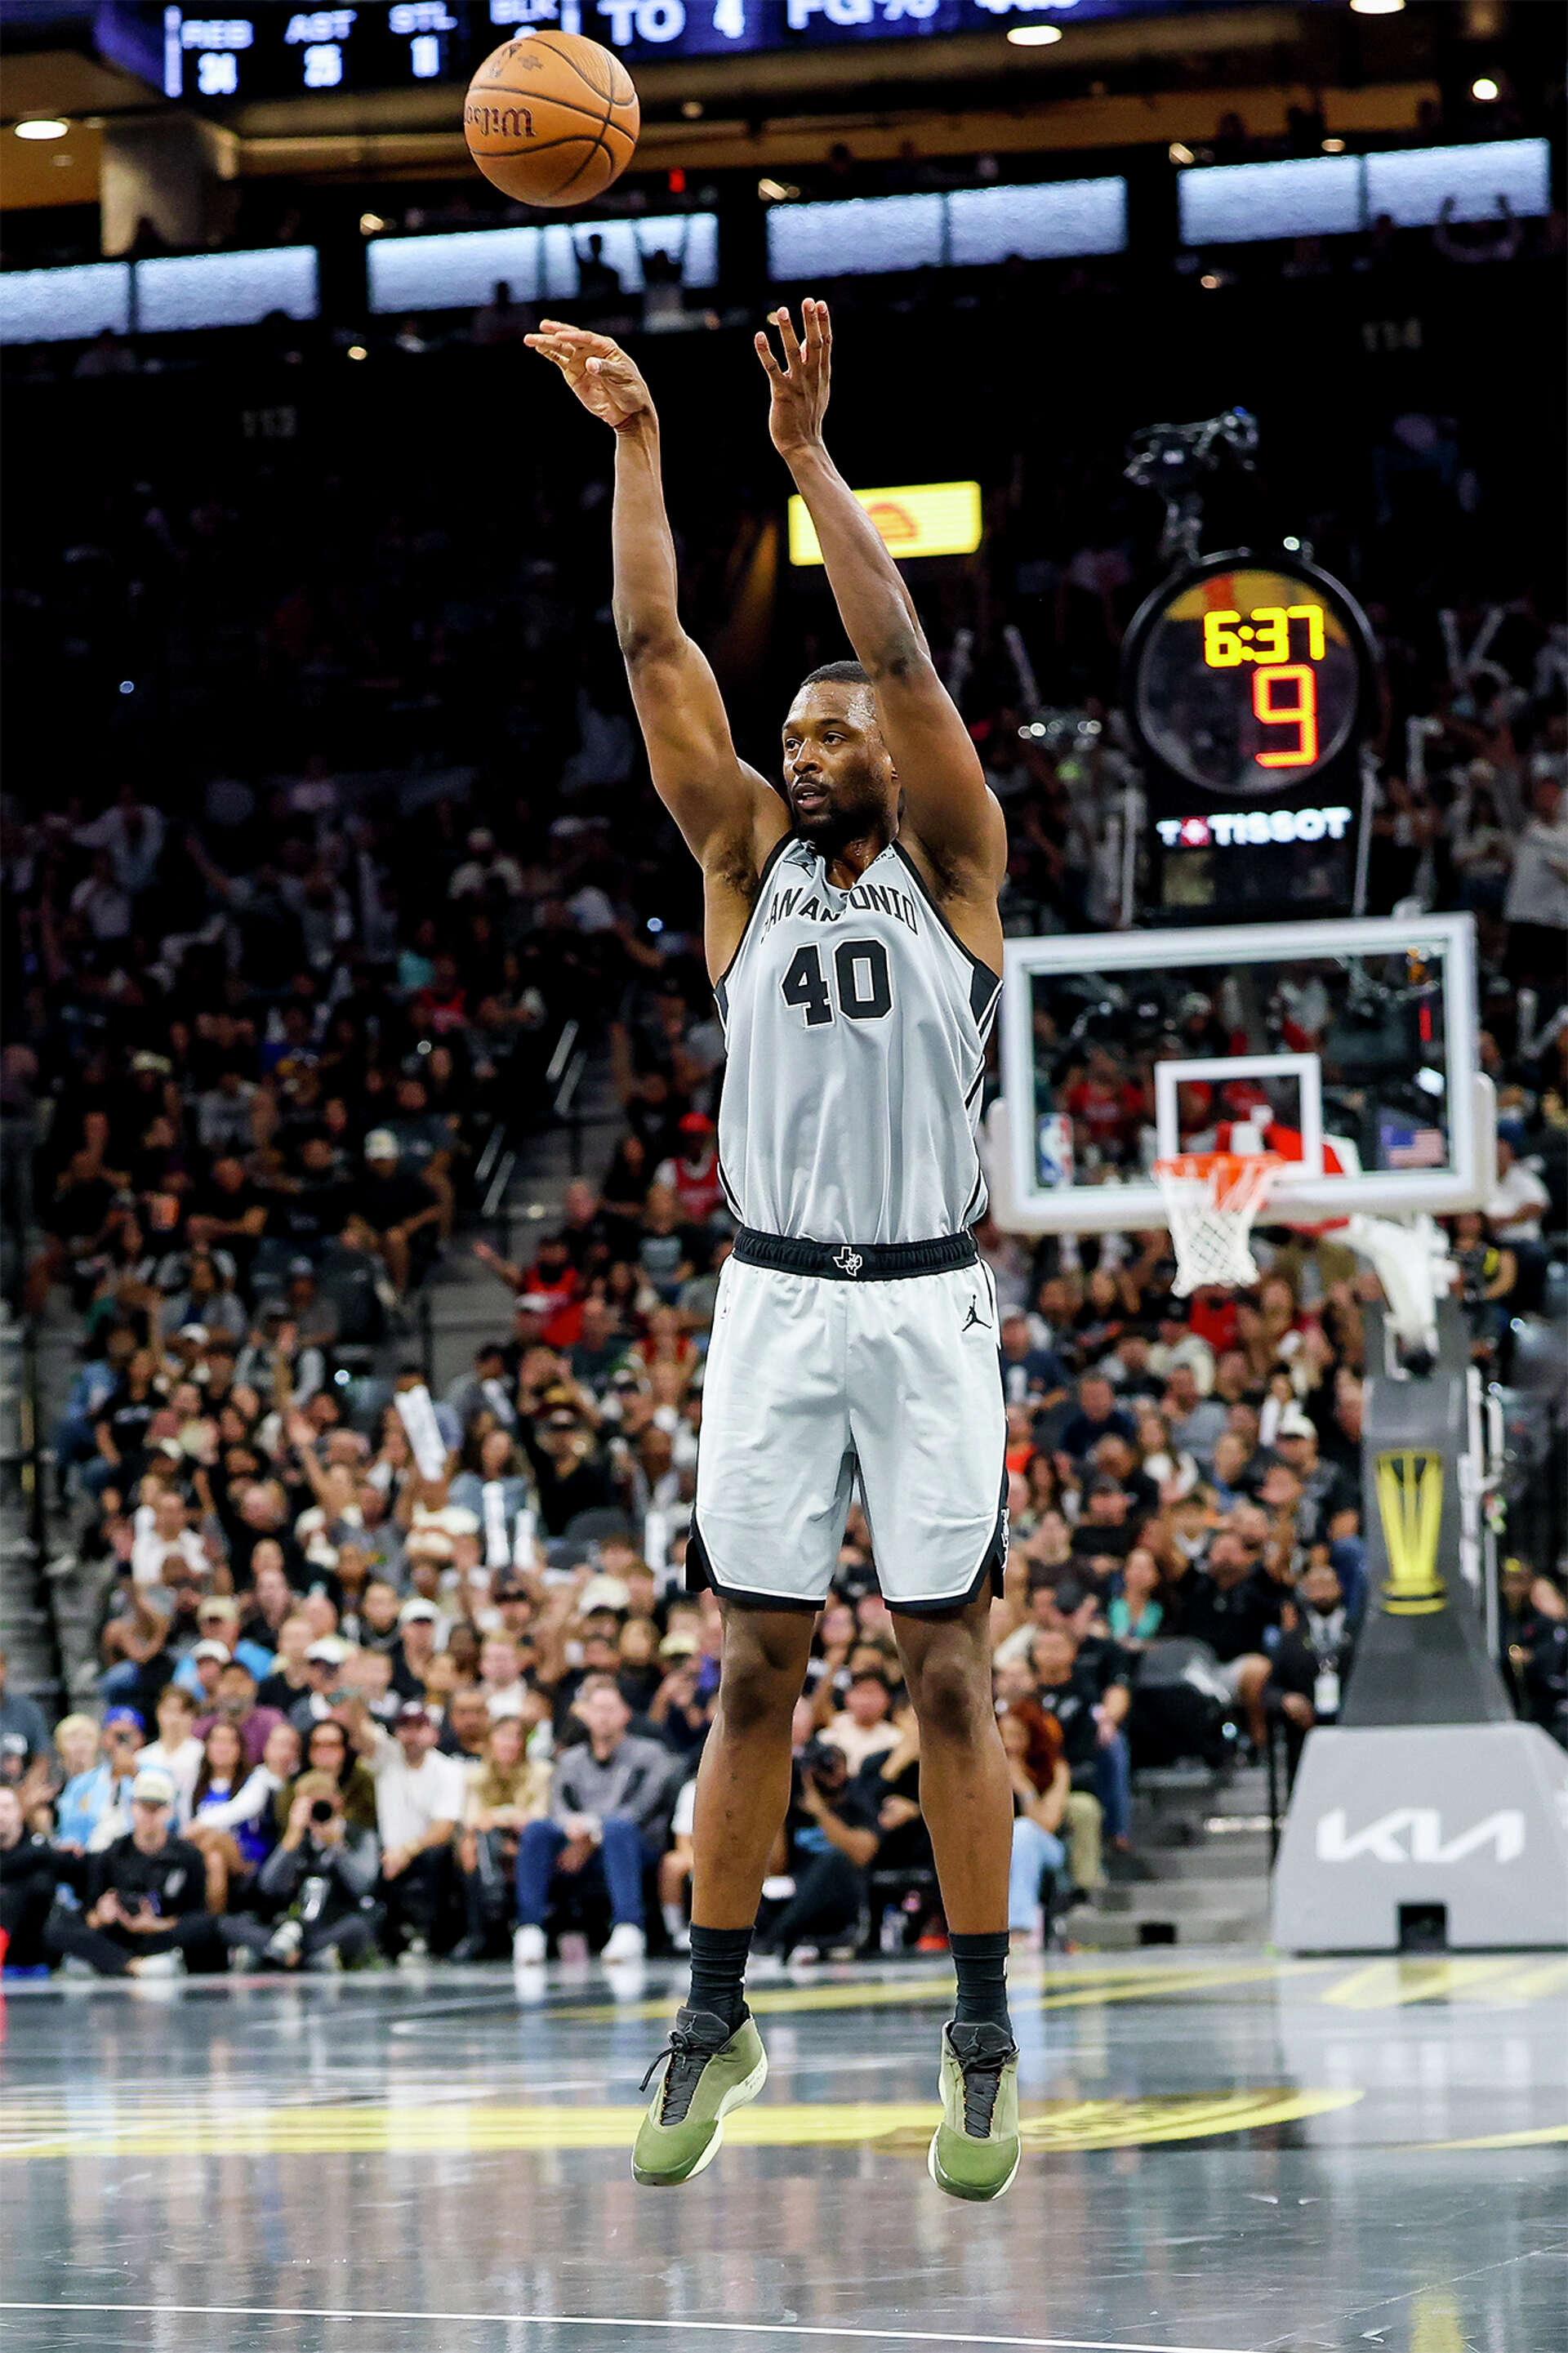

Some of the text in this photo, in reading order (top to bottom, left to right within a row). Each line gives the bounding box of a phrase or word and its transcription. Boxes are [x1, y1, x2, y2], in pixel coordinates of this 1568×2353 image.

[284, 9, 358, 44] AST
[596, 0, 686, 46] TO
[464, 105, 537, 137] Wilso
[1203, 604, 1326, 668] 6:37
[1253, 664, 1320, 769] 9
[1206, 806, 1352, 847] TISSOT
[797, 884, 920, 937] ANONIO
[779, 938, 894, 1027] 40
[1316, 1807, 1526, 1864] KIA
